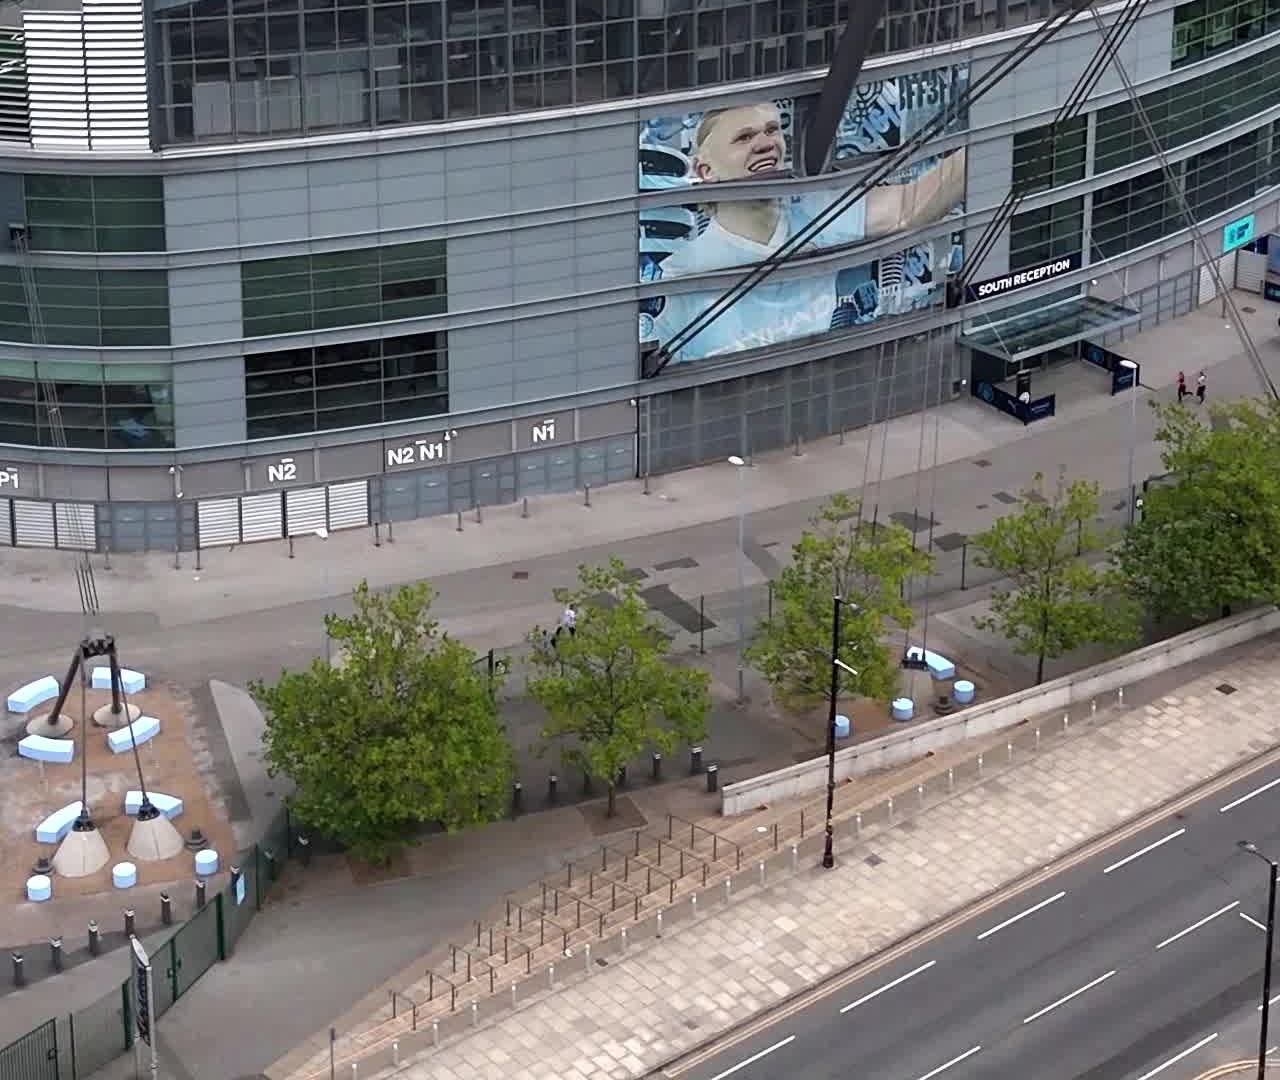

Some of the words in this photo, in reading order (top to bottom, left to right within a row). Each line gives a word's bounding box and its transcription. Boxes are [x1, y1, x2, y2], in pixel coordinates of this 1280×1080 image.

[978, 277, 1012, 296] SOUTH
[1013, 259, 1071, 286] RECEPTION
[532, 423, 555, 443] N1
[387, 447, 415, 466] N2
[419, 442, 443, 461] N1
[268, 463, 297, 482] N2
